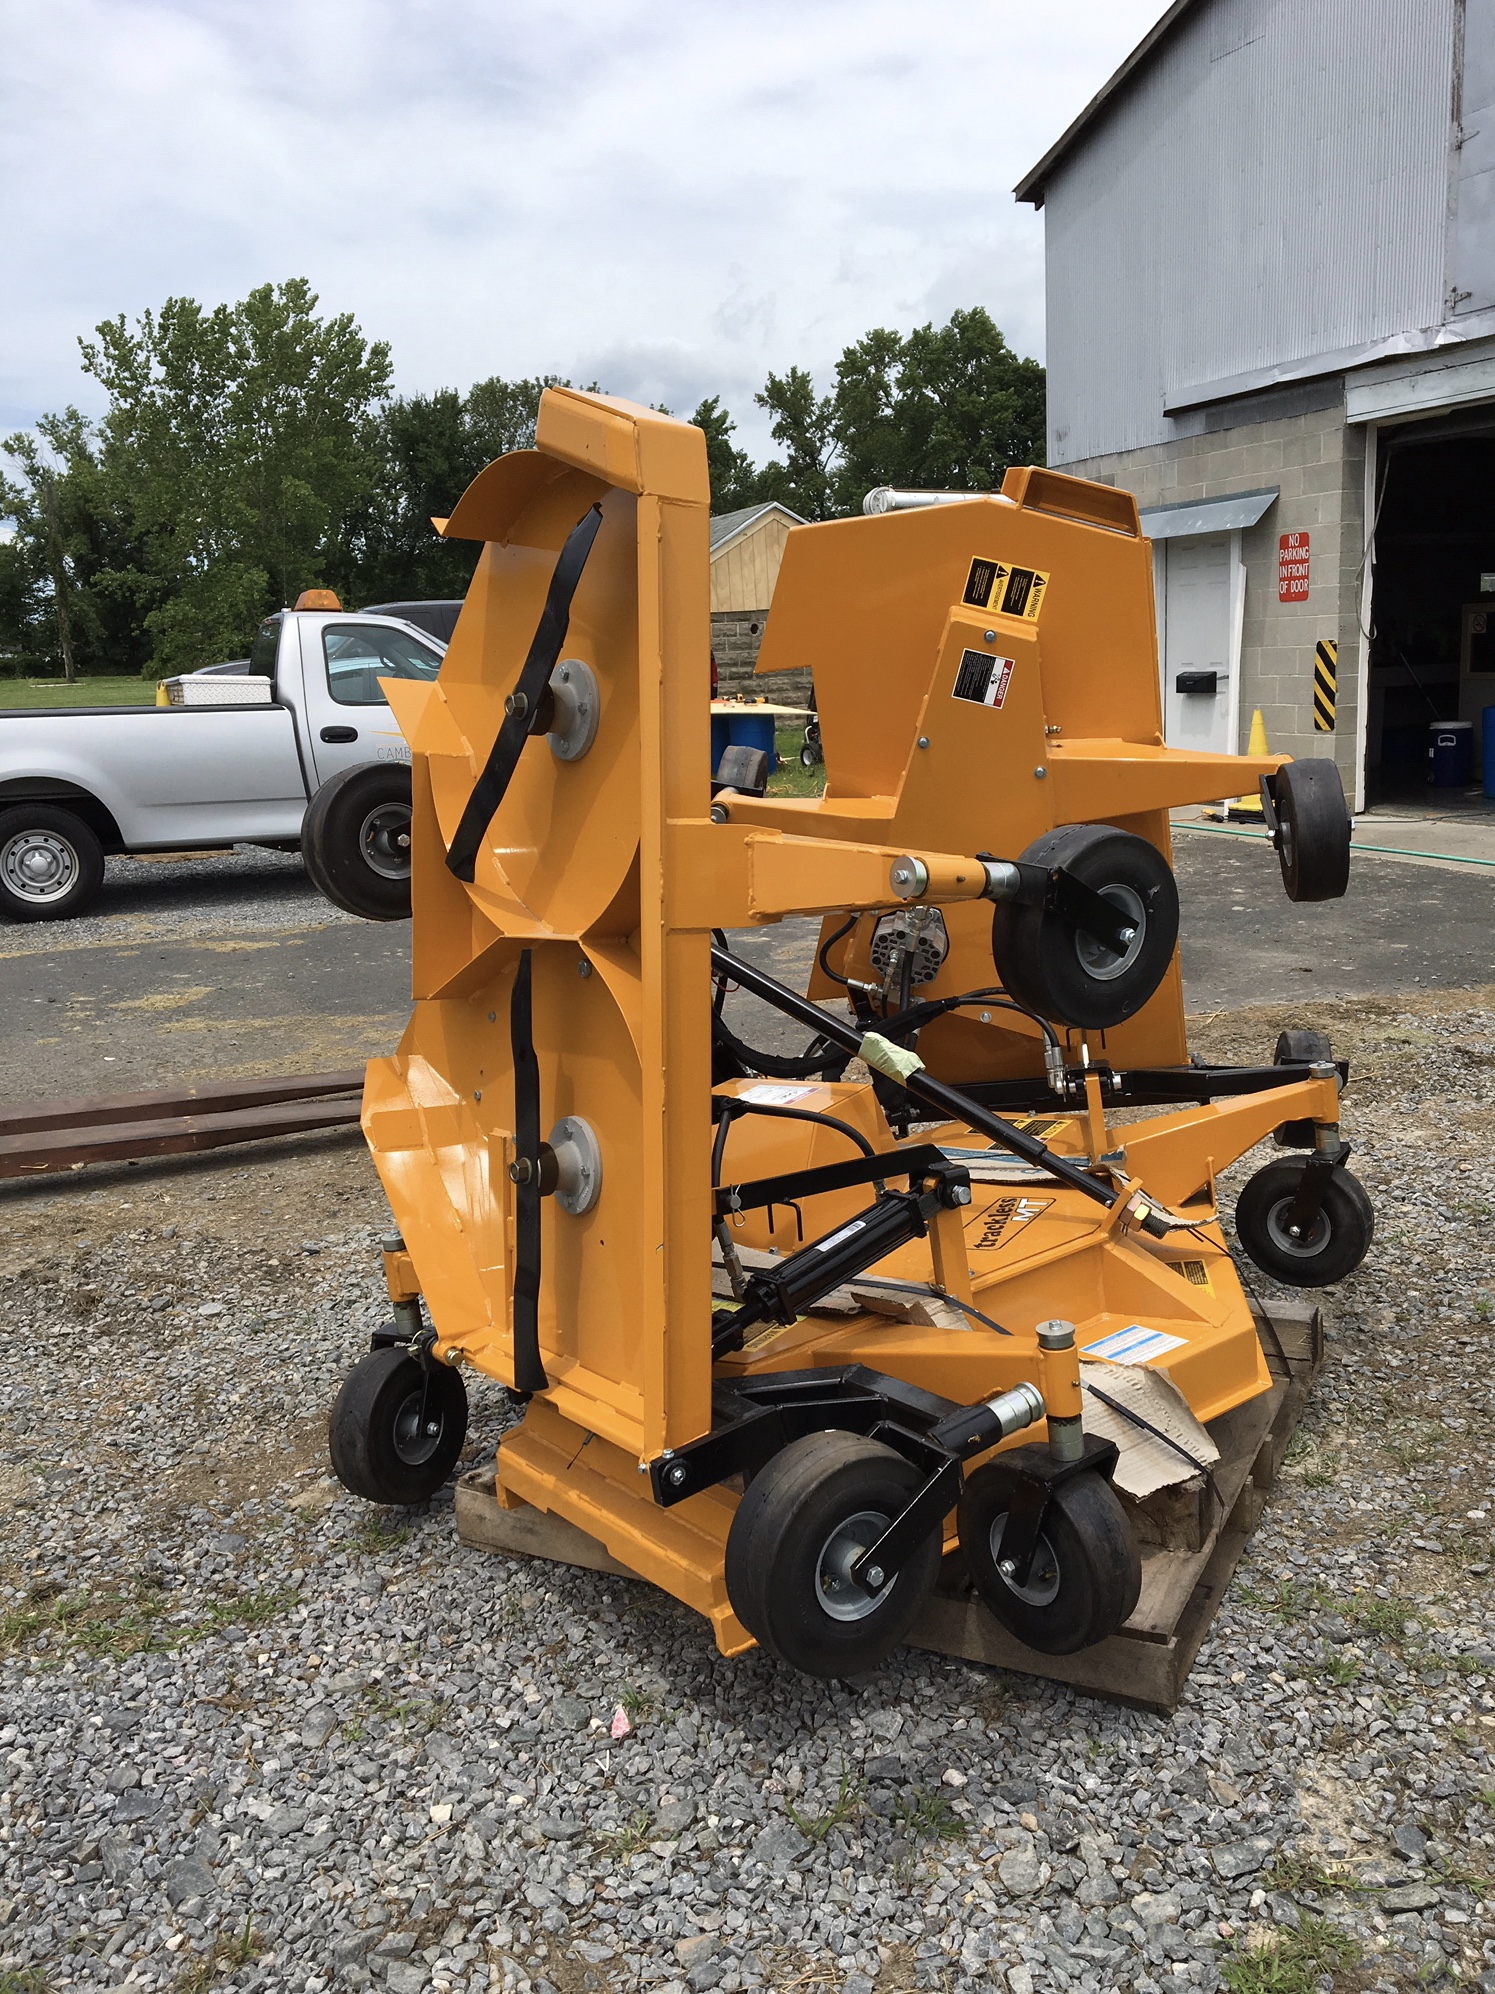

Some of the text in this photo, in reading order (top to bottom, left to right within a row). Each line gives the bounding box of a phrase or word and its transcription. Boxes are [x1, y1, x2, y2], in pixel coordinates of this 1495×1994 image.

[1288, 534, 1300, 547] NO
[1280, 547, 1309, 561] PARKING
[1280, 563, 1309, 577] IN FRONT
[1279, 579, 1309, 593] OF DOOR
[1028, 588, 1042, 618] WARNING
[996, 674, 1009, 700] DANGER
[1011, 1198, 1049, 1222] MT
[973, 1198, 1018, 1249] trackless
